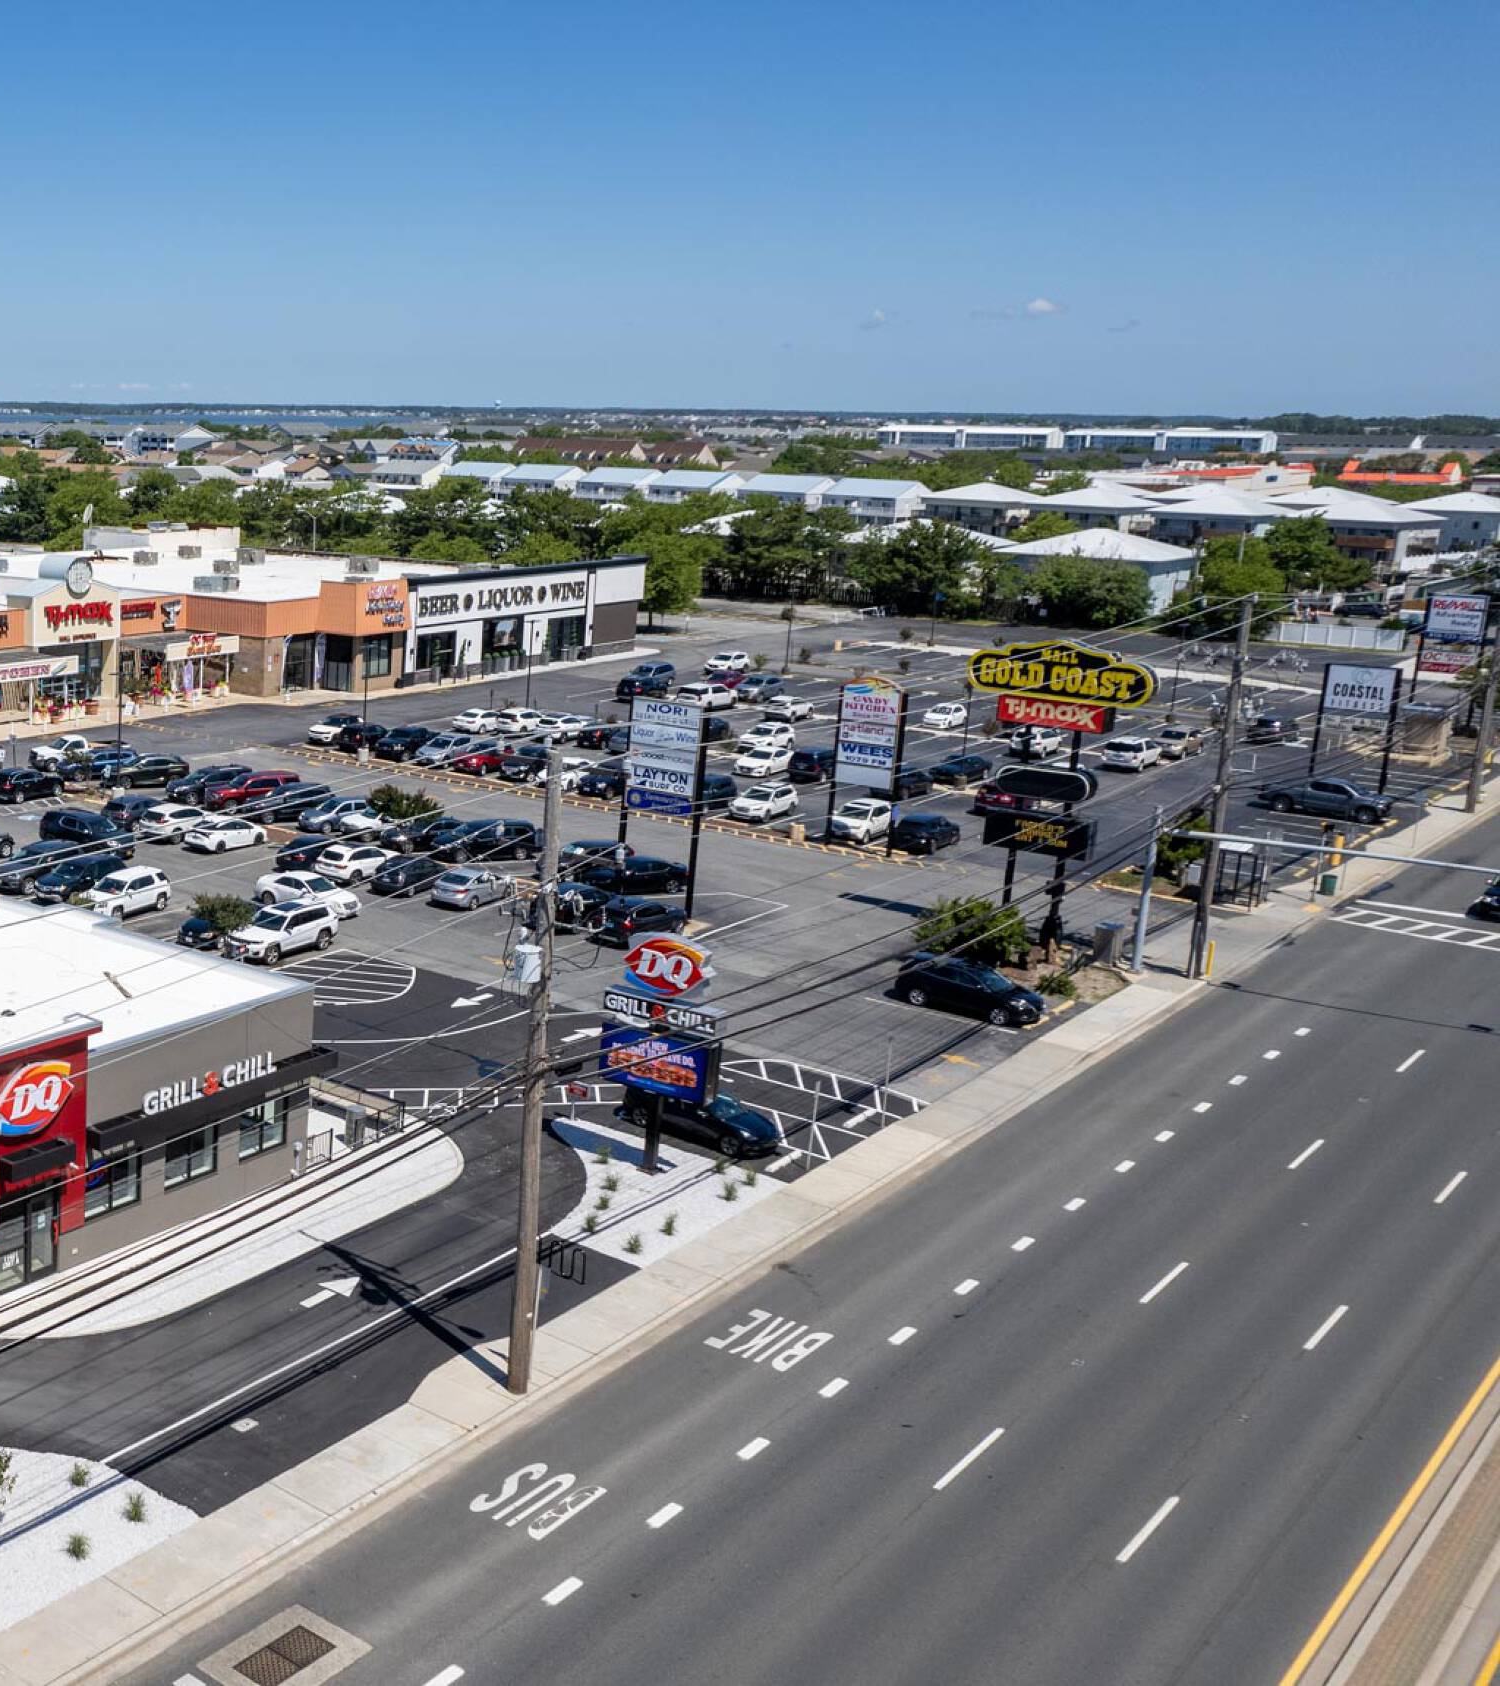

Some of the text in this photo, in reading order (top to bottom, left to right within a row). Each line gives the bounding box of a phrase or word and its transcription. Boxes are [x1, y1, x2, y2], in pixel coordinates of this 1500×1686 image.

[419, 581, 585, 616] BEER LIQUOR WINE
[1042, 648, 1079, 664] MALL
[980, 657, 1136, 699] GOLD COAST
[1333, 683, 1385, 700] COASTAL
[646, 704, 688, 716] NORI
[632, 727, 655, 737] Liquor
[676, 732, 698, 744] Wine
[841, 743, 893, 758] WEES
[633, 766, 688, 785] LAYTON
[636, 948, 694, 989] DQ
[605, 994, 716, 1034] GRILL & CHILL
[9, 1075, 63, 1120] DQ
[142, 1051, 278, 1116] GRILL & CHILL
[703, 1307, 834, 1372] BIKE
[469, 1461, 608, 1541] BUS
